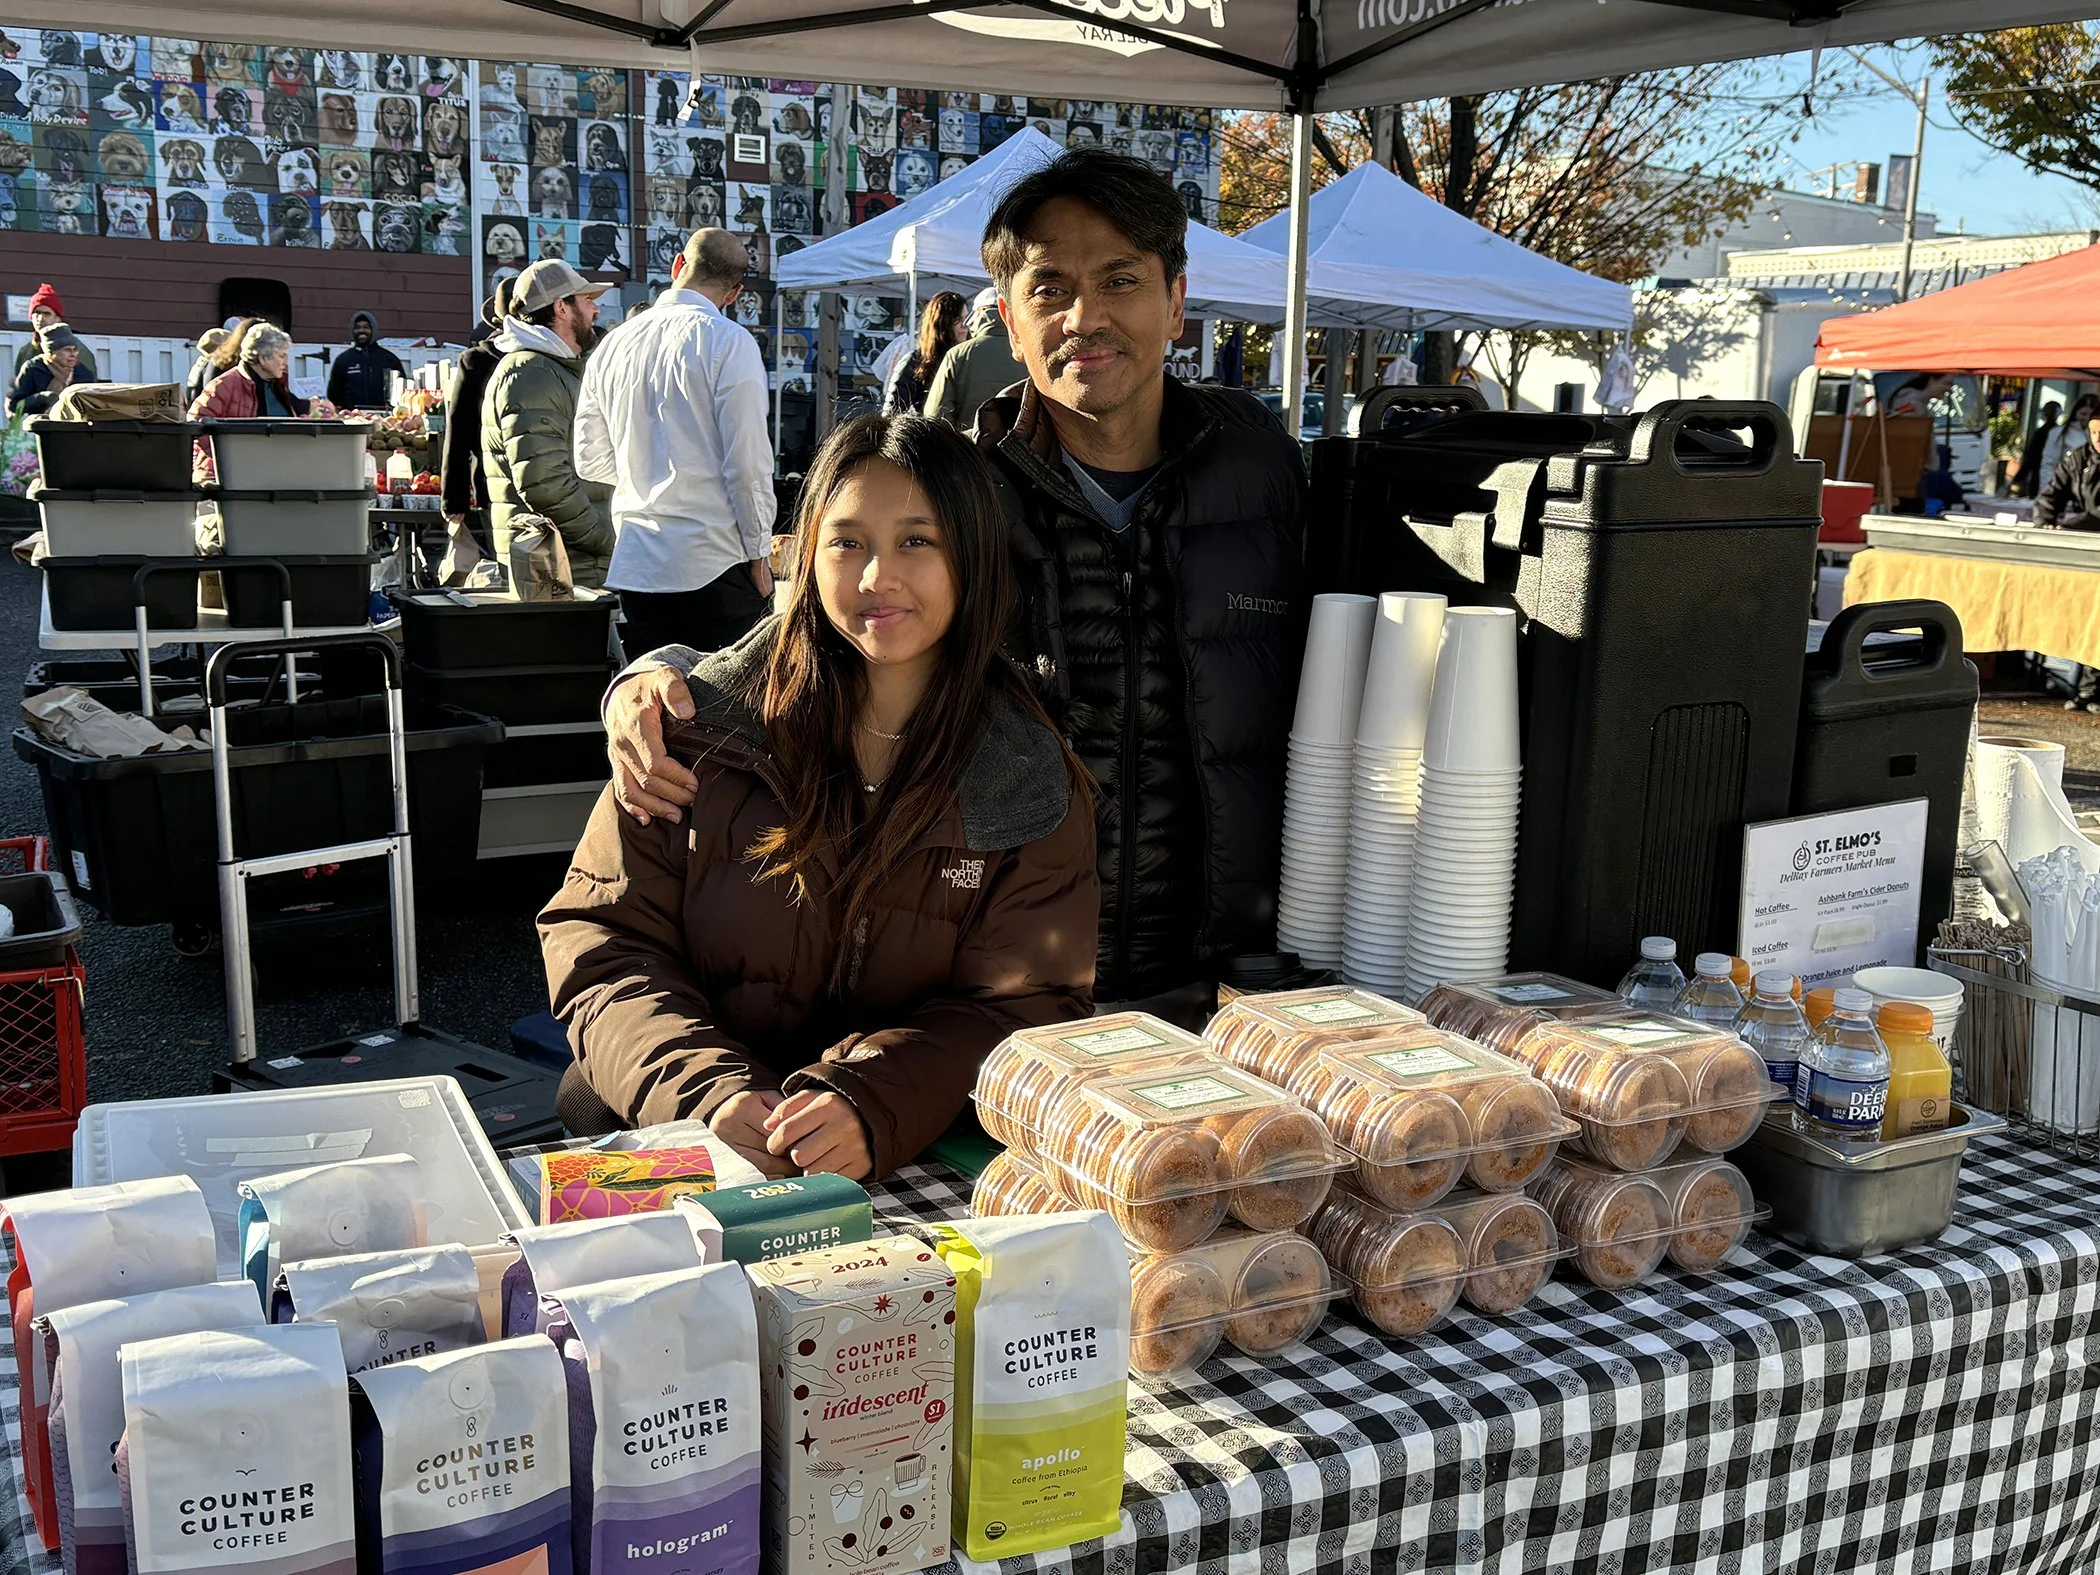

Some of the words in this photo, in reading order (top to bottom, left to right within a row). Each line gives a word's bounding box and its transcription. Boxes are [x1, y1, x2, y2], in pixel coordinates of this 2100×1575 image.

[437, 97, 467, 107] TITUS
[383, 193, 417, 202] COCO
[1815, 839, 1833, 855] ST.
[1835, 831, 1882, 851] ELMO'S
[960, 859, 980, 870] THE
[1810, 866, 1843, 878] Farmers
[1844, 860, 1873, 873] Market
[1874, 856, 1896, 868] Menu
[1816, 852, 1854, 866] COFFEE
[1857, 849, 1876, 858] PUB
[941, 868, 979, 879] NORTH
[951, 879, 978, 888] FACE
[1818, 892, 1846, 903] Ashbank
[1847, 888, 1868, 899] Farm's
[1870, 885, 1887, 895] Cider
[1887, 882, 1909, 892] Donuts
[1755, 907, 1767, 915] Hot
[1768, 902, 1790, 913] Coffee
[1752, 944, 1766, 953] Iced
[1768, 941, 1789, 951] Coffee
[1802, 972, 1824, 982] Orange
[1825, 968, 1841, 978] Juice
[1842, 965, 1855, 973] and
[1855, 959, 1887, 970] Lemonade
[1851, 1089, 1888, 1105] DEER
[1848, 1104, 1886, 1120] PARK
[742, 1182, 805, 1200] 2024
[760, 1226, 841, 1251] COUNTER
[831, 1256, 889, 1274] 2024
[836, 1333, 917, 1359] COUNTER
[1005, 1326, 1096, 1356] COUNTER
[347, 1340, 436, 1375] OUNTER
[836, 1348, 917, 1374] CULTURE
[1005, 1344, 1097, 1374] CULTURE
[855, 1367, 899, 1384] COFFEE
[1028, 1368, 1078, 1388] COFFEE
[822, 1380, 929, 1421] iridescent
[623, 1397, 728, 1437] COUNTER
[860, 1413, 876, 1421] winter
[878, 1409, 893, 1417] blend
[623, 1417, 729, 1456] CULTURE
[830, 1434, 856, 1444] blueberry
[860, 1427, 891, 1439] marmalade
[894, 1419, 920, 1430] chocolate
[416, 1434, 535, 1473] COUNTER
[651, 1444, 707, 1470] COFFEE
[1022, 1448, 1081, 1471] apollo
[416, 1454, 536, 1495] CULTURE
[1012, 1475, 1036, 1484] coffee
[1038, 1471, 1057, 1481] from
[1058, 1465, 1088, 1477] Ethiopia
[179, 1482, 315, 1515] COUNTER
[446, 1482, 513, 1508] COFFEE
[930, 1464, 938, 1530] RELEASE
[1021, 1498, 1038, 1506] citrus
[1043, 1493, 1058, 1502] floral
[180, 1502, 315, 1535] CULTURE
[808, 1493, 816, 1560] LIMITED
[213, 1531, 287, 1550] COFFEE
[627, 1523, 729, 1559] hologram
[863, 1566, 879, 1574] bean
[880, 1561, 900, 1571] coffee
